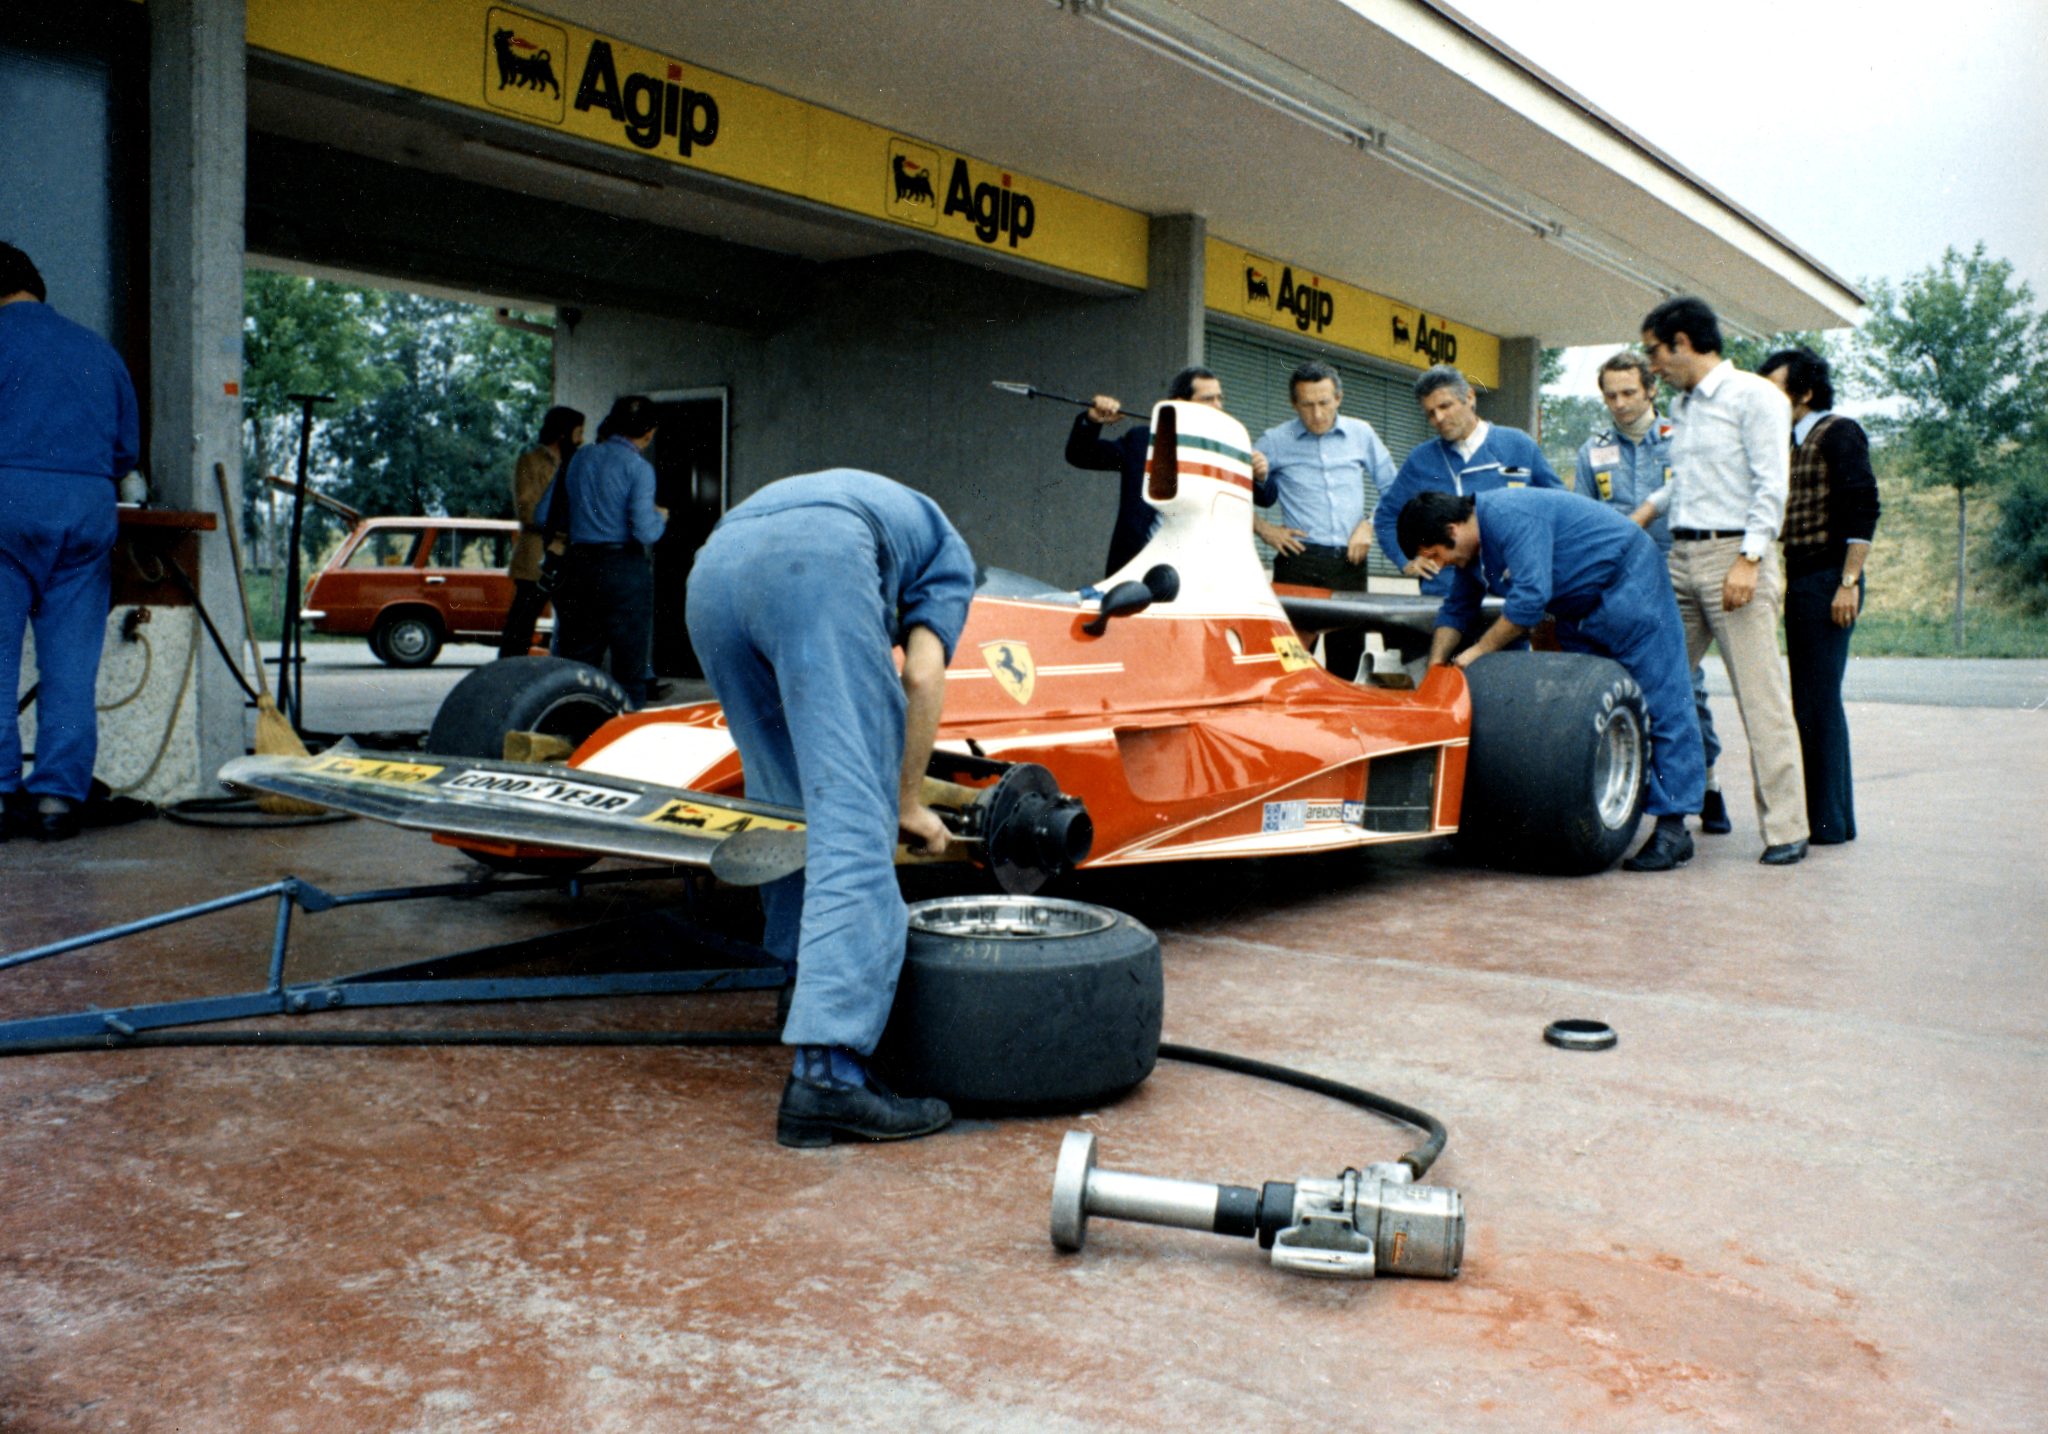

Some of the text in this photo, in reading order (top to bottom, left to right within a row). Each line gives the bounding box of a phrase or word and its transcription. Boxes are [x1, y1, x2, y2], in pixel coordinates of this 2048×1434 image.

[574, 39, 720, 158] Agip
[943, 158, 1036, 248] Agip
[1275, 266, 1334, 333] Agip
[1414, 313, 1458, 366] Agip
